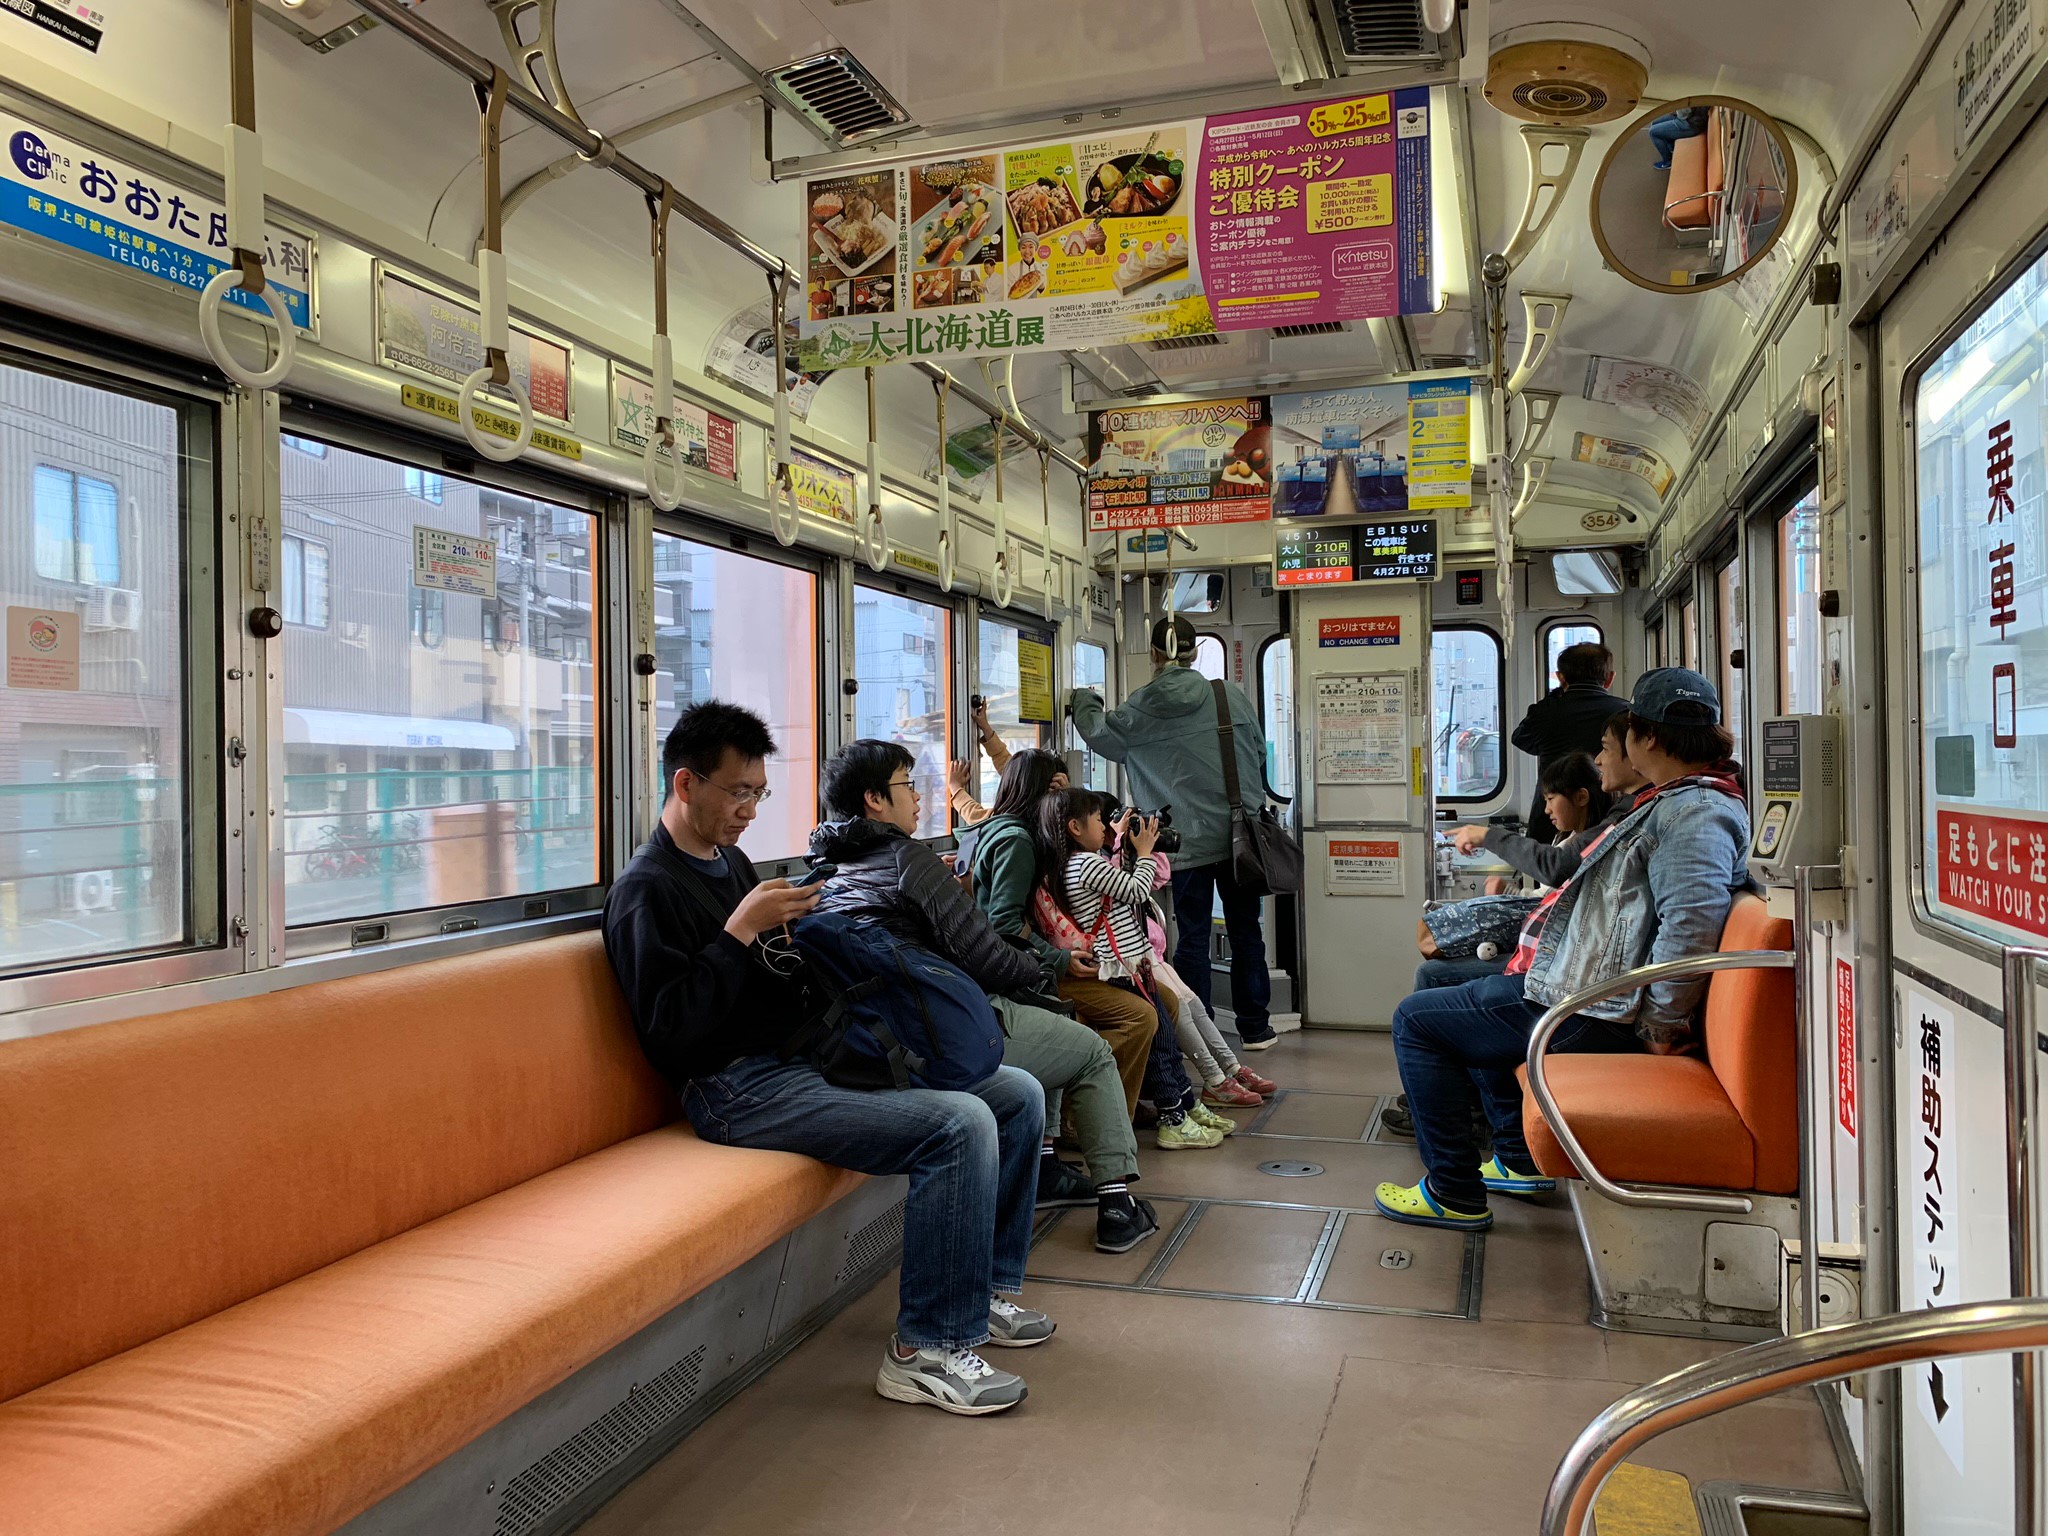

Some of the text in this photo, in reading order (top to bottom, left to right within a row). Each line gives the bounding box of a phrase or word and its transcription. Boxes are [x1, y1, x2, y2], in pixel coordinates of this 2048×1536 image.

[36, 12, 95, 47] HANKAI Route map
[1973, 73, 1992, 116] through
[1992, 62, 2002, 89] the
[2002, 39, 2016, 75] front
[2016, 21, 2030, 54] door
[1286, 132, 1392, 156] あべのハルカス5周年記念
[23, 137, 70, 168] Derma
[26, 158, 67, 184] Clinic
[1208, 154, 1346, 193] 特別クーポン
[1208, 184, 1301, 217] ご優待会
[1319, 195, 1379, 209] お買いあげの際に
[1319, 204, 1379, 217] ご利用いただける
[1209, 215, 1281, 232] おトク情報満載の
[1209, 227, 1267, 242] クーポン優待
[1337, 249, 1389, 265] Kintetsu
[858, 308, 1045, 361] 大北海道展
[398, 351, 455, 380] 06-6622-2565
[1098, 401, 1262, 433] 10連休はマルハンへ!!
[1412, 420, 1425, 438] 2
[1091, 472, 1211, 491] メガシティ堺 堺遠里小野店
[1105, 491, 1147, 504] 石津北駅
[1167, 487, 1211, 501] 大和川駅
[1586, 514, 1615, 528] 354
[1281, 542, 1348, 555] 大人 210円
[1364, 537, 1408, 547] この電車は
[452, 544, 471, 557] 210円
[474, 549, 492, 561] 110円
[1372, 546, 1407, 556] 恵美須町
[1397, 552, 1434, 564] 行きです
[1281, 556, 1348, 569] 小児 110円
[1278, 570, 1342, 582] 次 とまります
[1987, 418, 2017, 749] 乗車口
[1322, 621, 1397, 633] おつりはでません
[1338, 637, 1369, 646] CHANGE
[1372, 637, 1395, 645] GIVEN
[1358, 688, 1380, 696] 210円
[1675, 688, 1701, 697] Tigers
[1332, 845, 1395, 855] 定期乗車券について
[1948, 870, 2048, 925] WATCH YOUR S
[1919, 1012, 1945, 1309] 補助ステッ
